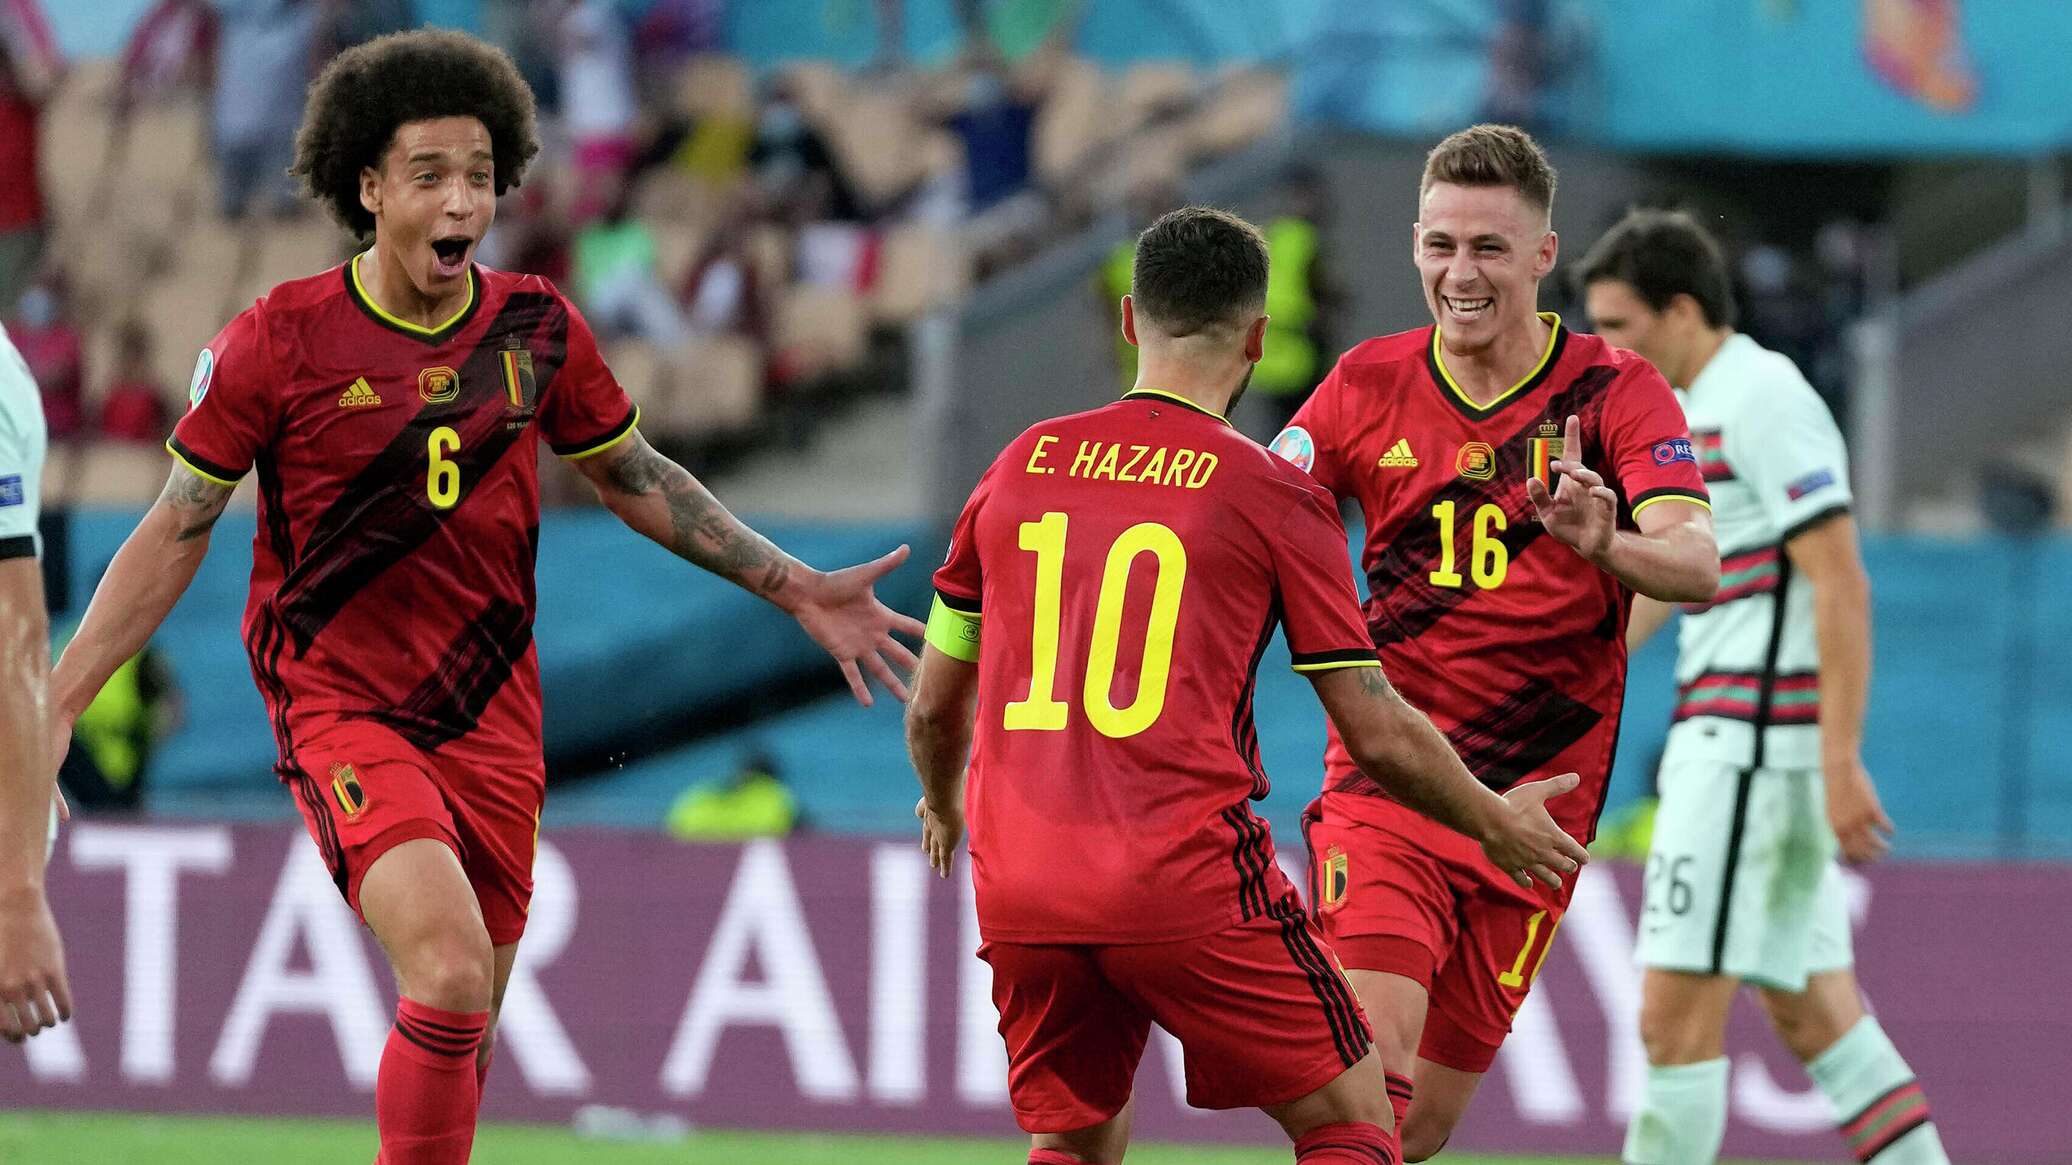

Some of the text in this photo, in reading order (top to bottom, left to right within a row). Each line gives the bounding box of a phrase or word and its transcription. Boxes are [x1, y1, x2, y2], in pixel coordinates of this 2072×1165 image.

[338, 394, 382, 407] adidas
[427, 426, 461, 509] 6
[1025, 435, 1219, 489] E. HAZARD
[1378, 455, 1419, 467] adidas
[1429, 500, 1509, 590] 16
[1003, 511, 1188, 738] 10
